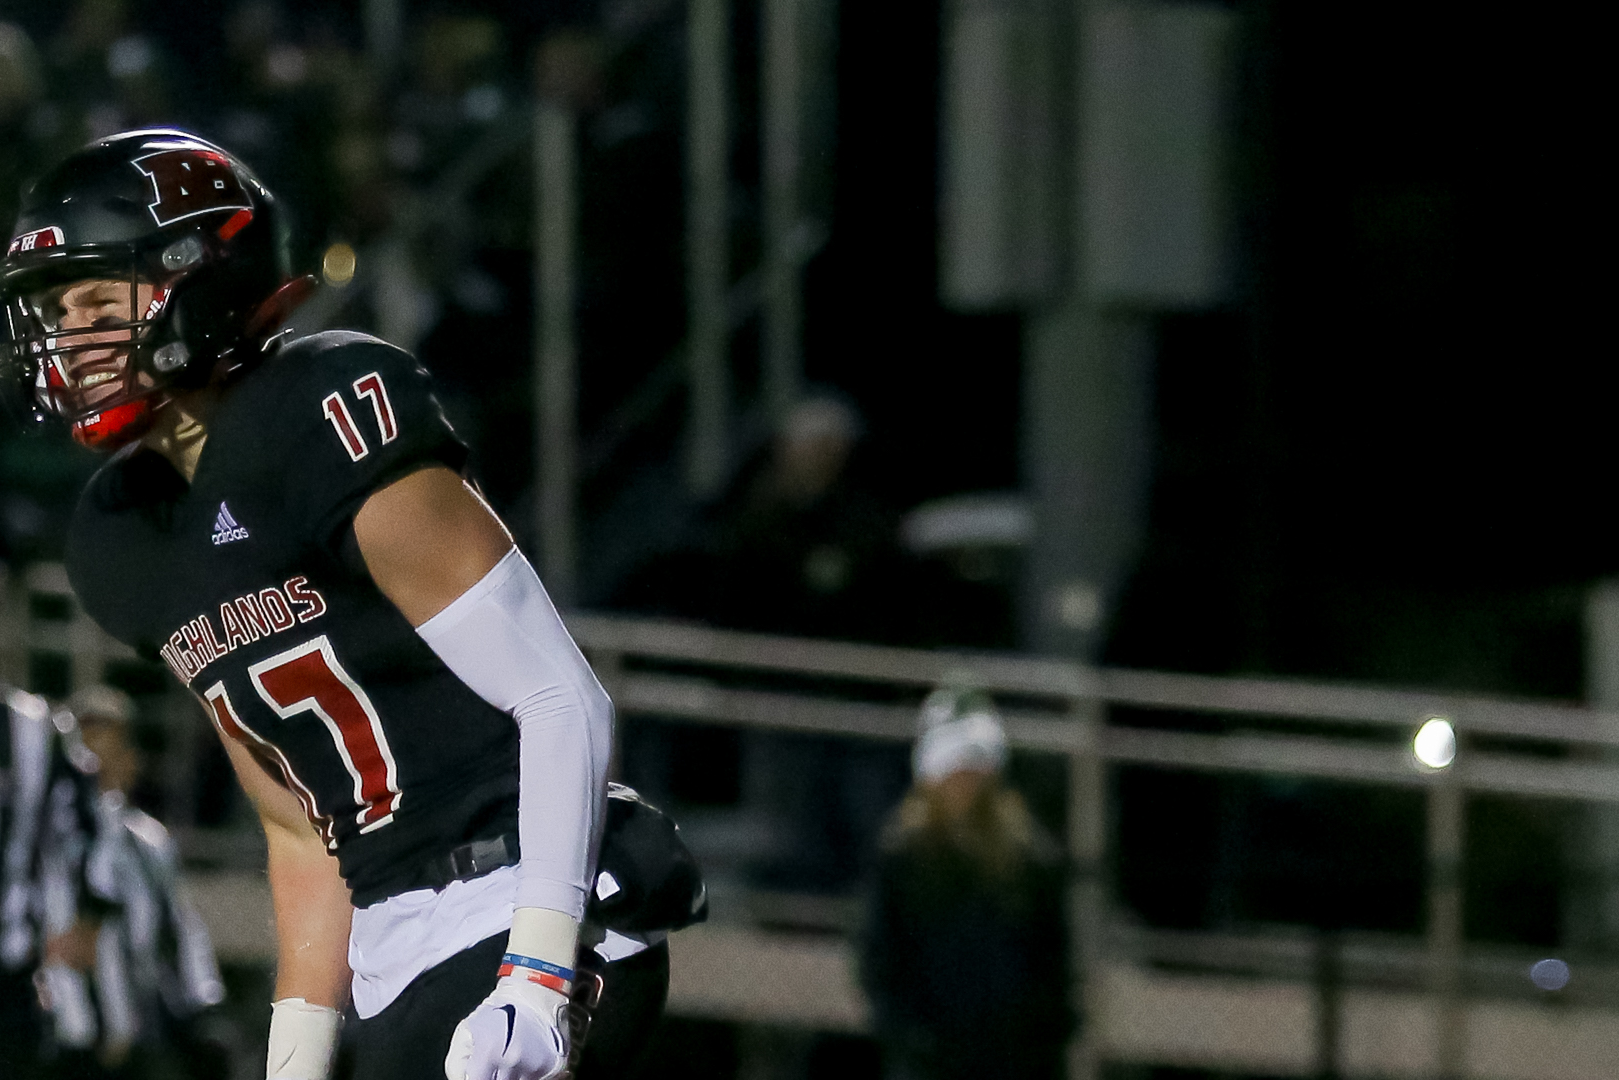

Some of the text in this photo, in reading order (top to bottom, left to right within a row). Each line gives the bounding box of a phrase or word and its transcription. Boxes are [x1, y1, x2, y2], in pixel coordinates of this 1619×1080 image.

[322, 371, 398, 462] 17
[211, 527, 249, 545] adidas
[204, 634, 403, 851] 17
